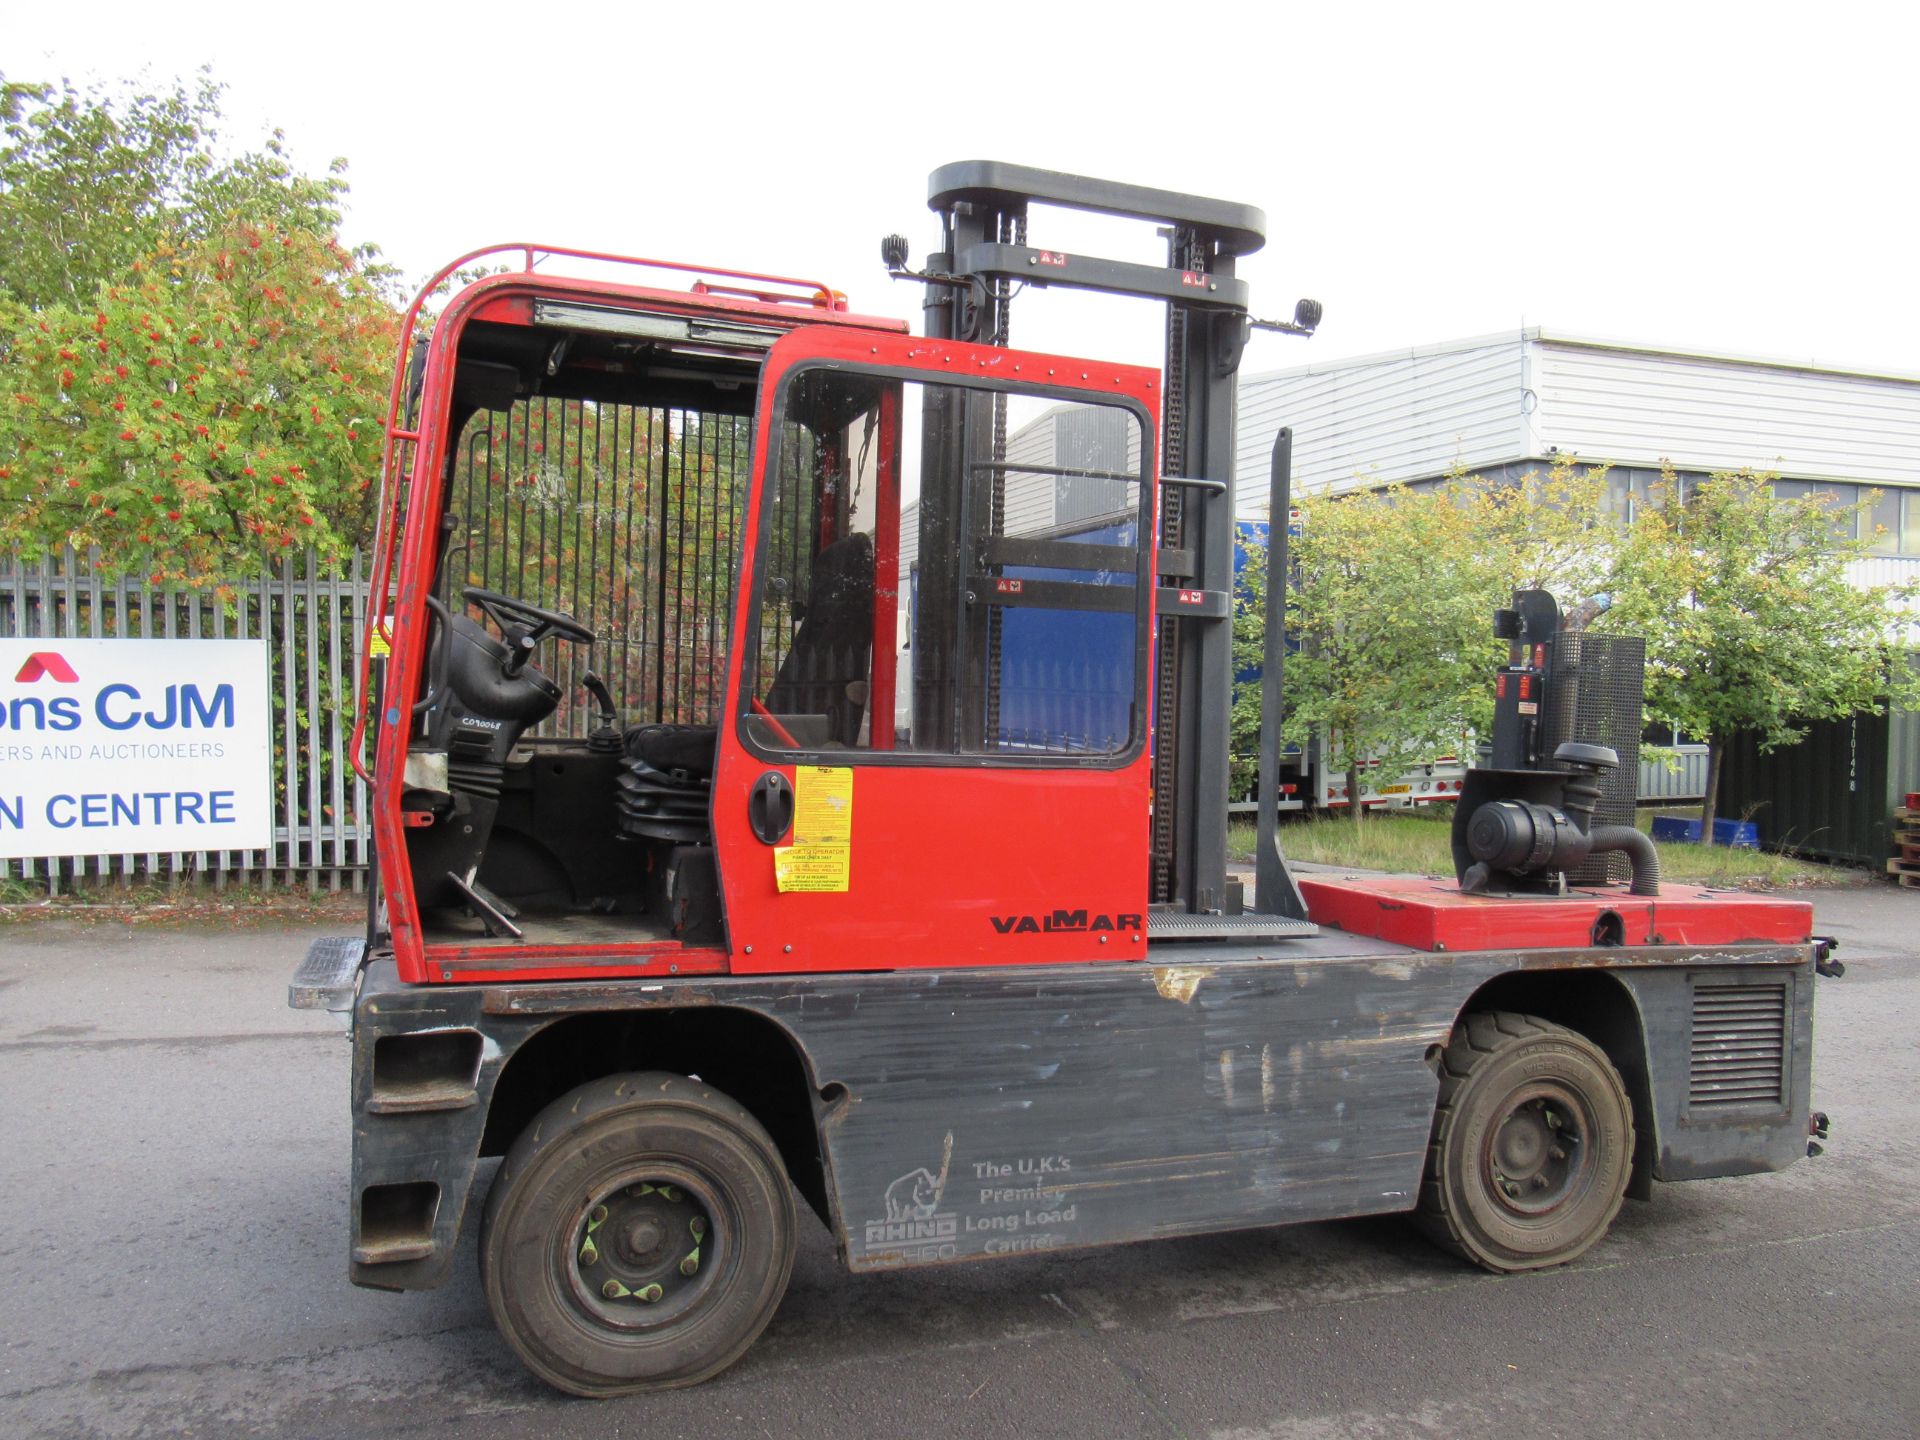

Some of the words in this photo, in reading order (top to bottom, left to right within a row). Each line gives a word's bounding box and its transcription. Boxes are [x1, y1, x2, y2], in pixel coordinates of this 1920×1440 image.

[0, 697, 82, 731] ns
[95, 683, 235, 730] CJM
[41, 745, 83, 760] AND
[89, 743, 225, 759] AUCTIONEERS
[46, 790, 236, 828] CENTRE
[990, 909, 1142, 934] VALMAR
[972, 1161, 1012, 1178] The
[1019, 1156, 1071, 1174] U.K.'s
[865, 1212, 957, 1243] RHINO
[965, 1214, 1019, 1232] Long
[1025, 1204, 1077, 1226] Load
[984, 1236, 1054, 1254] Carrier
